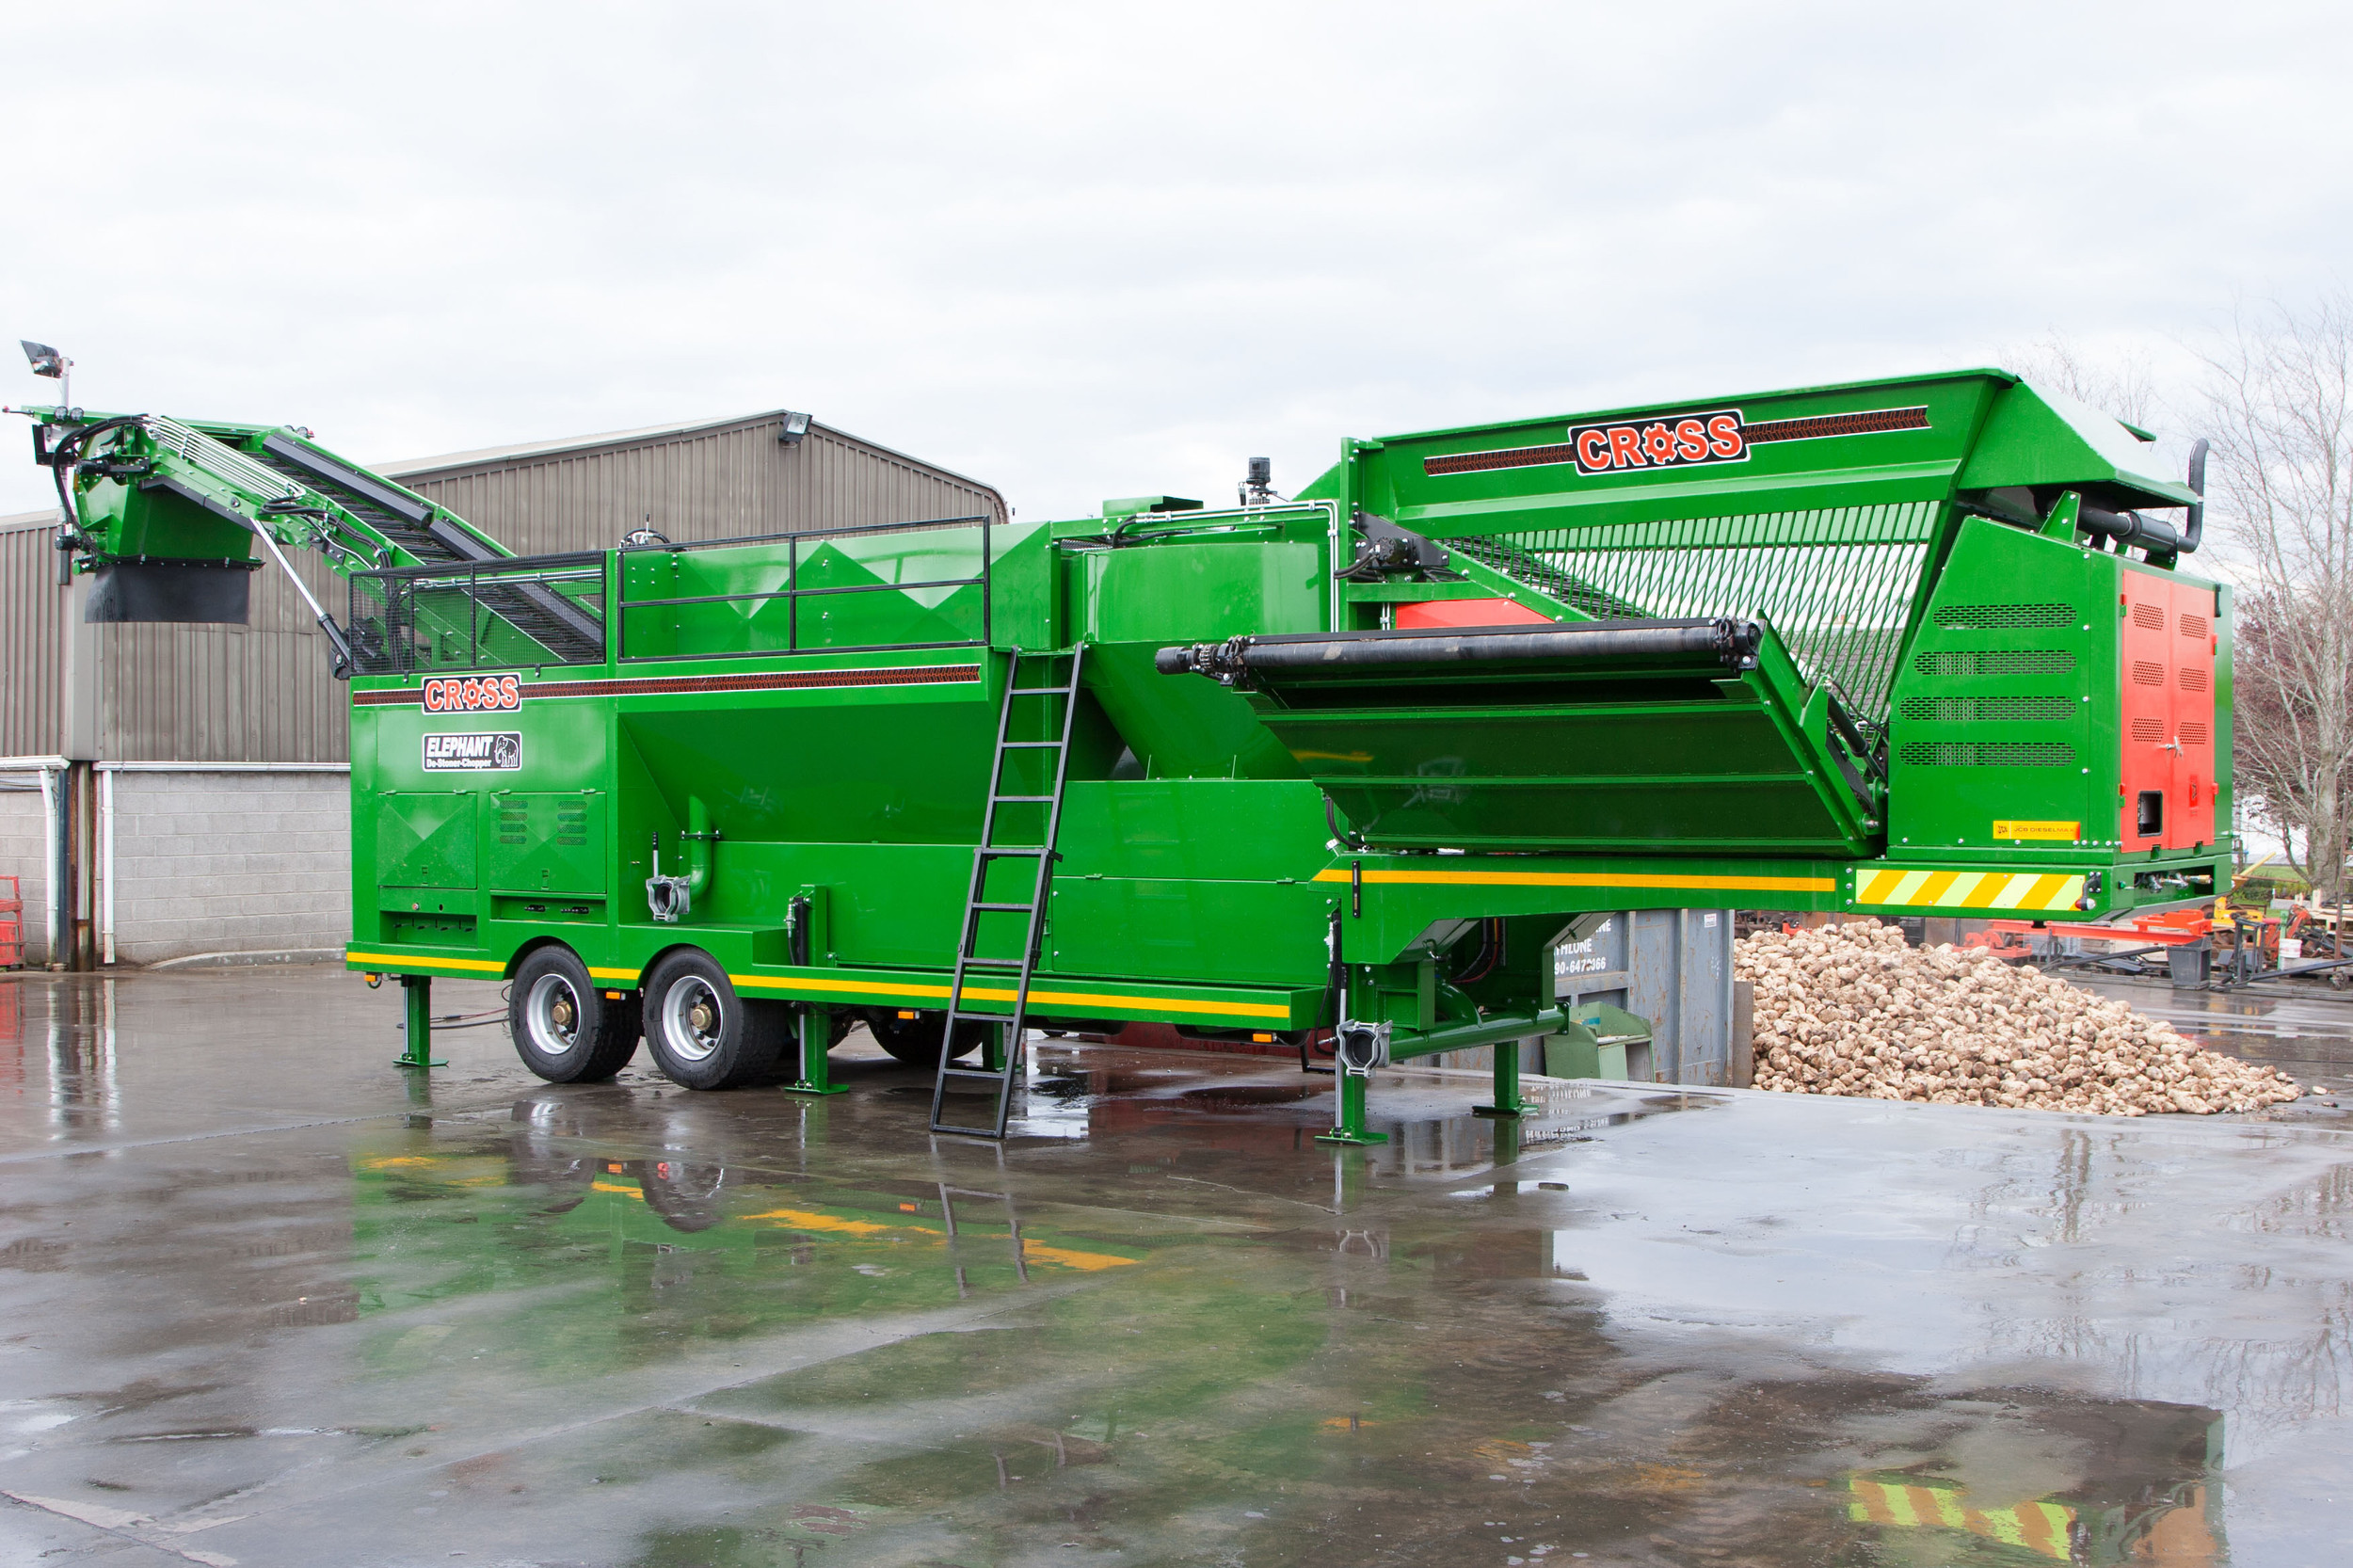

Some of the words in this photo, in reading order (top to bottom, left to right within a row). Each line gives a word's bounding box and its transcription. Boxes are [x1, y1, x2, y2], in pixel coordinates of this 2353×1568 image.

[1577, 415, 1743, 470] CROSS
[424, 676, 520, 712] CROSS
[426, 735, 494, 758] ELEPHANT
[426, 758, 492, 769] De-Stoner-Chopper
[1595, 919, 1611, 933] NE
[1554, 937, 1593, 956] THLONE
